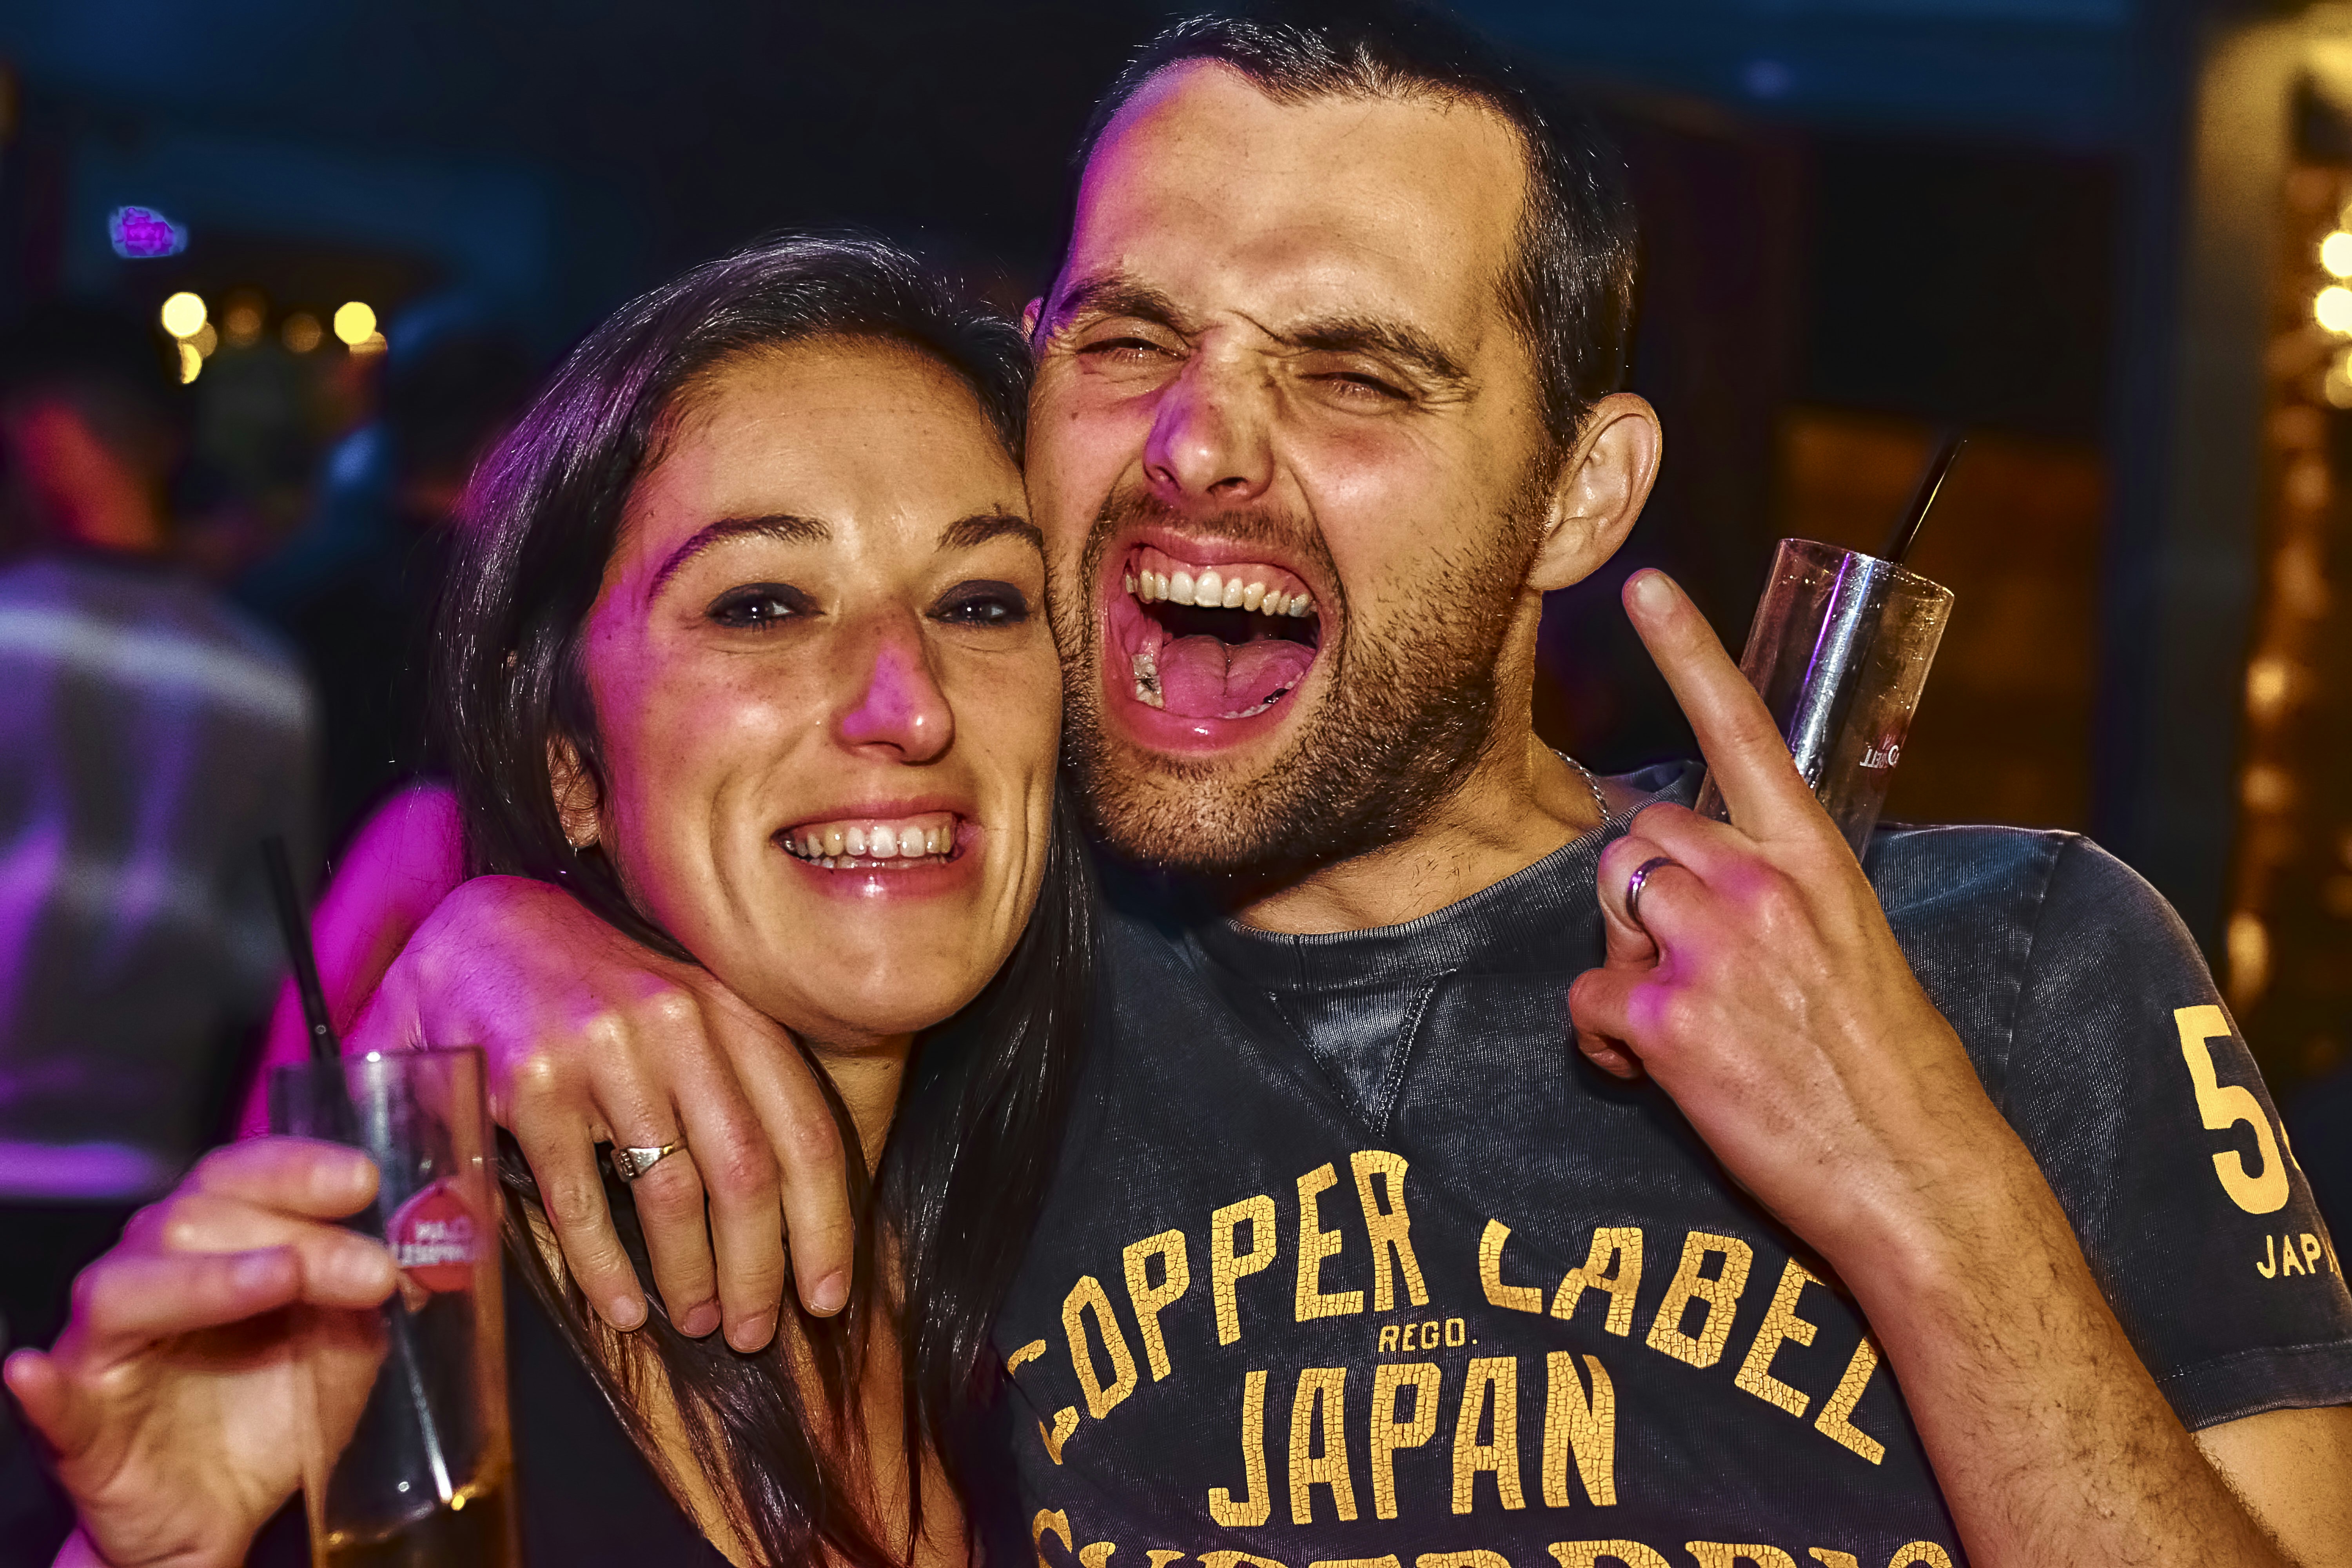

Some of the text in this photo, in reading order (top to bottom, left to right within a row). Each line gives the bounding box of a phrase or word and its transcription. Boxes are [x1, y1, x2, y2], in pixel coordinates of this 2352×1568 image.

[1479, 1218, 1885, 1465] LABEL
[2256, 1233, 2343, 1279] JAP
[1208, 1351, 1617, 1527] JAPAN
